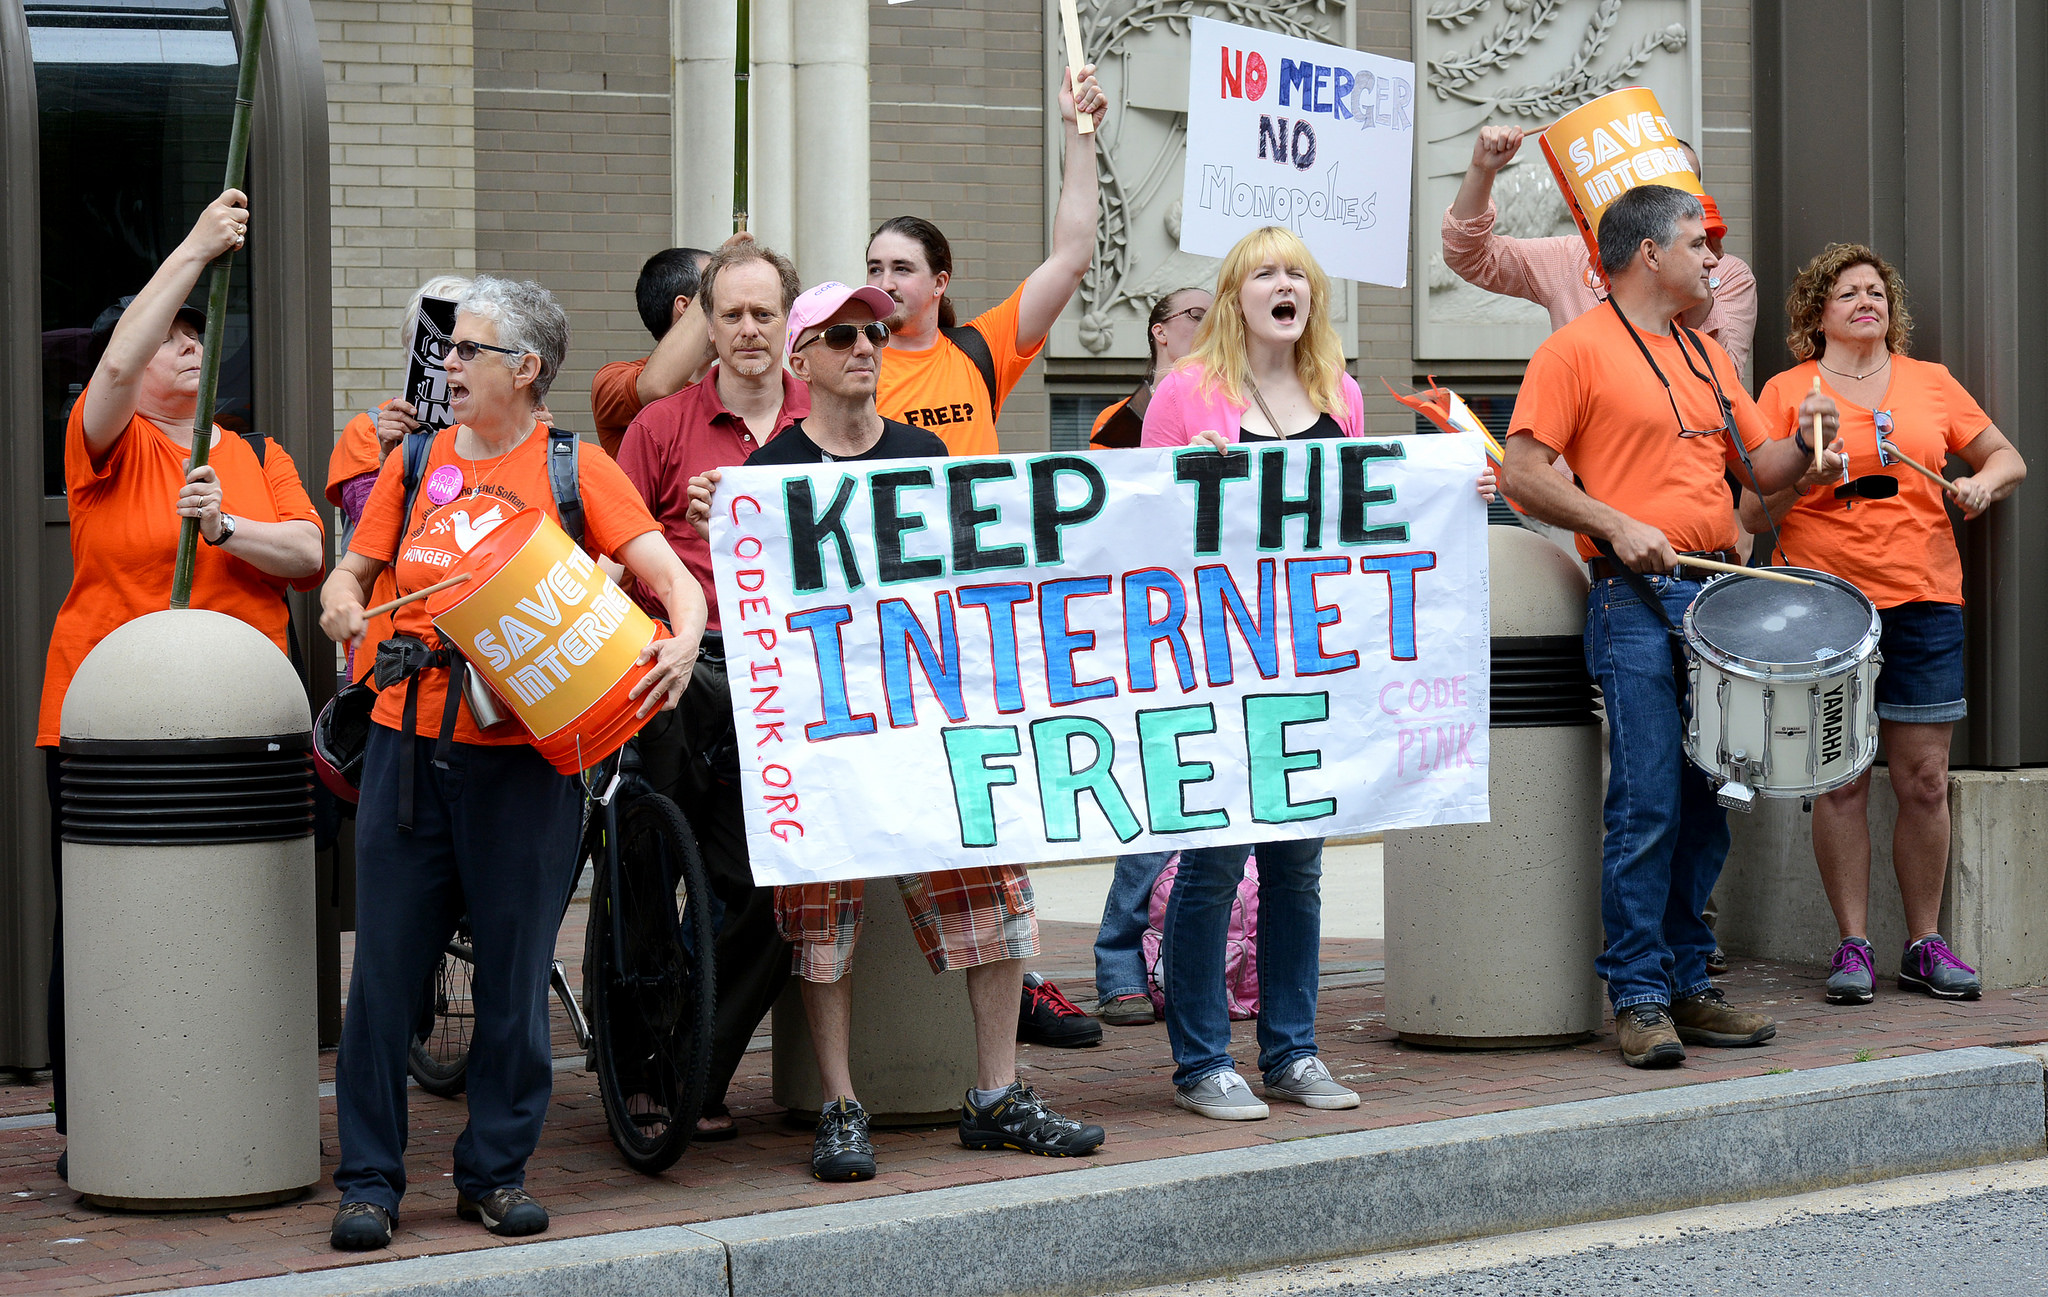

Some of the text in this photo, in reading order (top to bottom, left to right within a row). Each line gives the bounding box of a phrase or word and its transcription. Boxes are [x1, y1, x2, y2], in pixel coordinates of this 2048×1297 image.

[1220, 46, 1412, 131] NO MERGER
[1257, 114, 1316, 171] NO
[1568, 111, 1665, 178] SAVE
[904, 403, 974, 427] FREE?
[429, 480, 455, 496] PINK
[432, 472, 461, 488] CODE
[495, 485, 527, 512] Solitary
[782, 440, 1410, 595] KEEP THE
[402, 547, 452, 568] HUNGER
[473, 560, 588, 673] SAVE
[505, 574, 632, 707] INTERNE
[786, 550, 1437, 742] INTERNET
[1379, 675, 1468, 715] CODE
[1822, 683, 1844, 766] YAMAHA
[941, 691, 1337, 848] FREE
[1397, 722, 1476, 777] PINK
